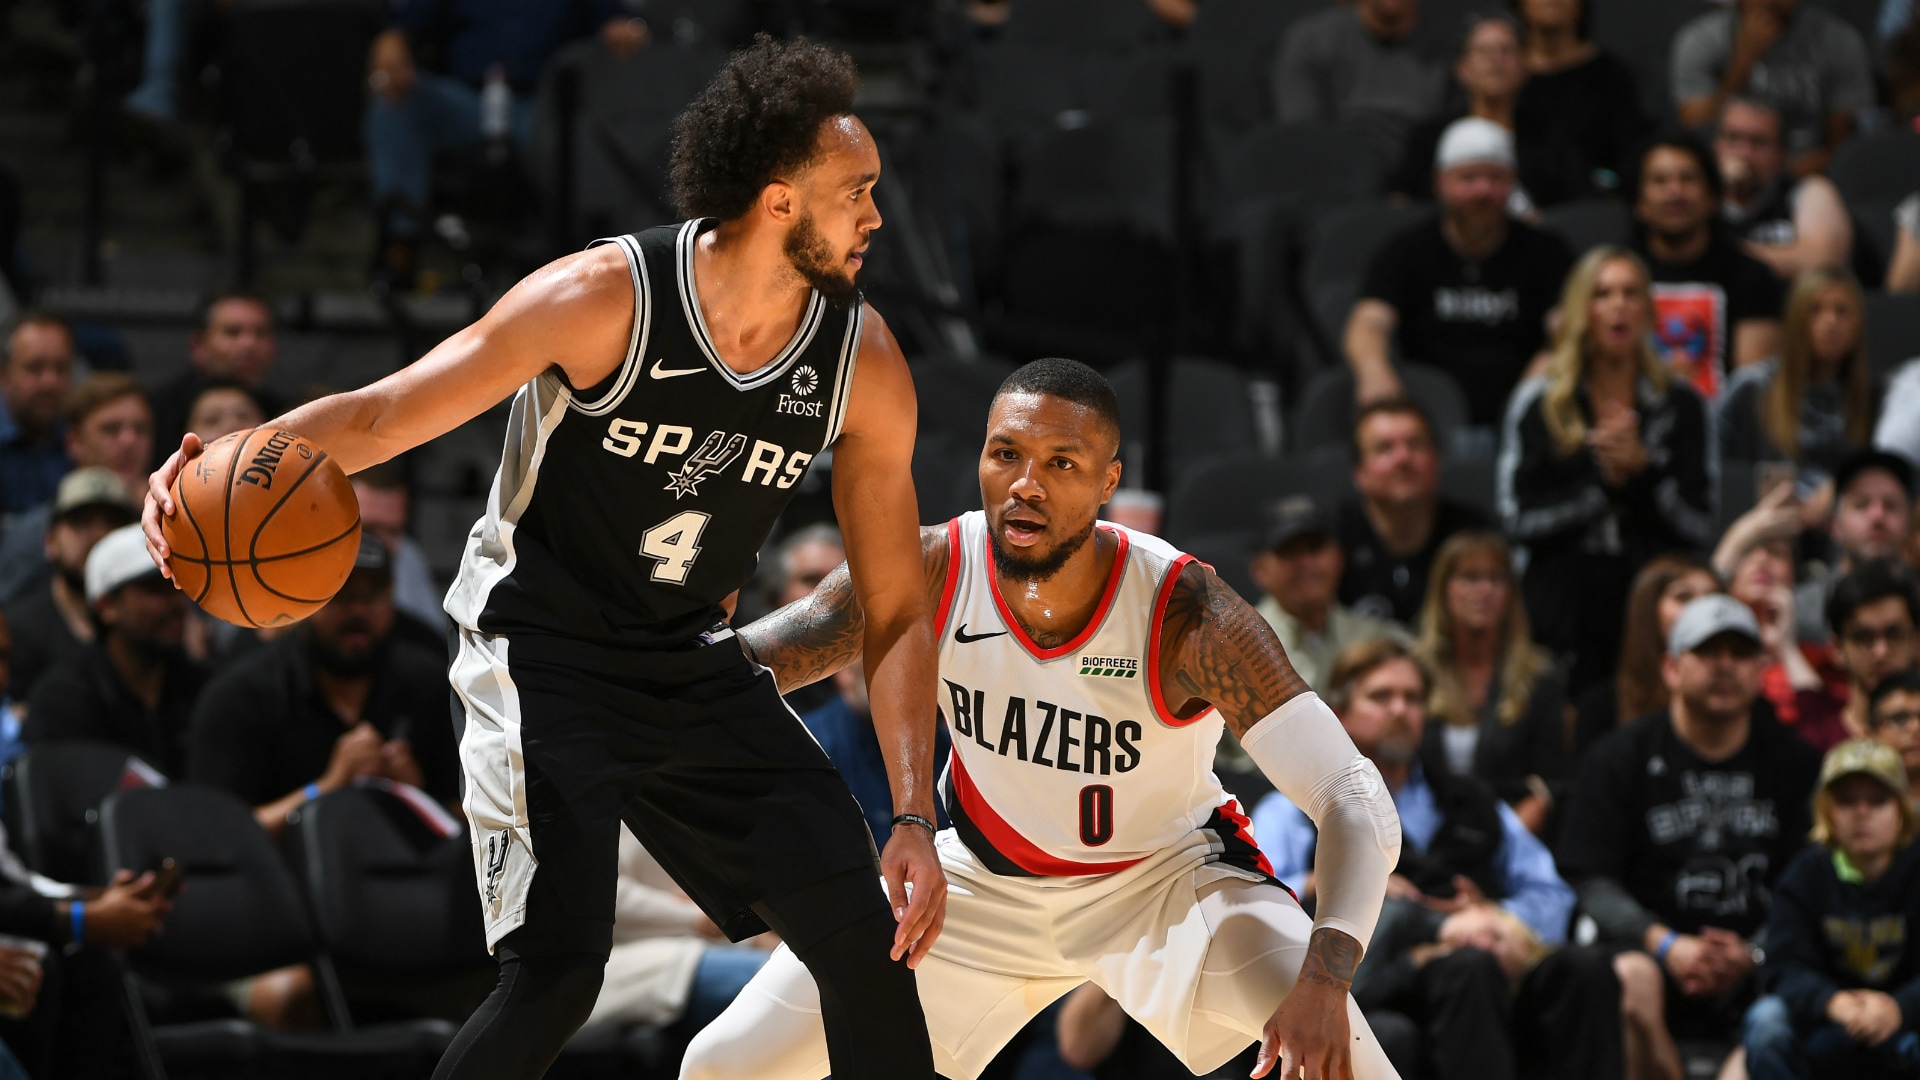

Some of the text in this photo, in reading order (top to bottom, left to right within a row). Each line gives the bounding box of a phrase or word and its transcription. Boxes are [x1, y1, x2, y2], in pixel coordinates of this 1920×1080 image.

[776, 394, 824, 418] Frost
[602, 418, 813, 499] SPURS
[639, 510, 712, 586] 4
[942, 677, 1142, 775] BLAZERS
[1079, 784, 1114, 847] 0
